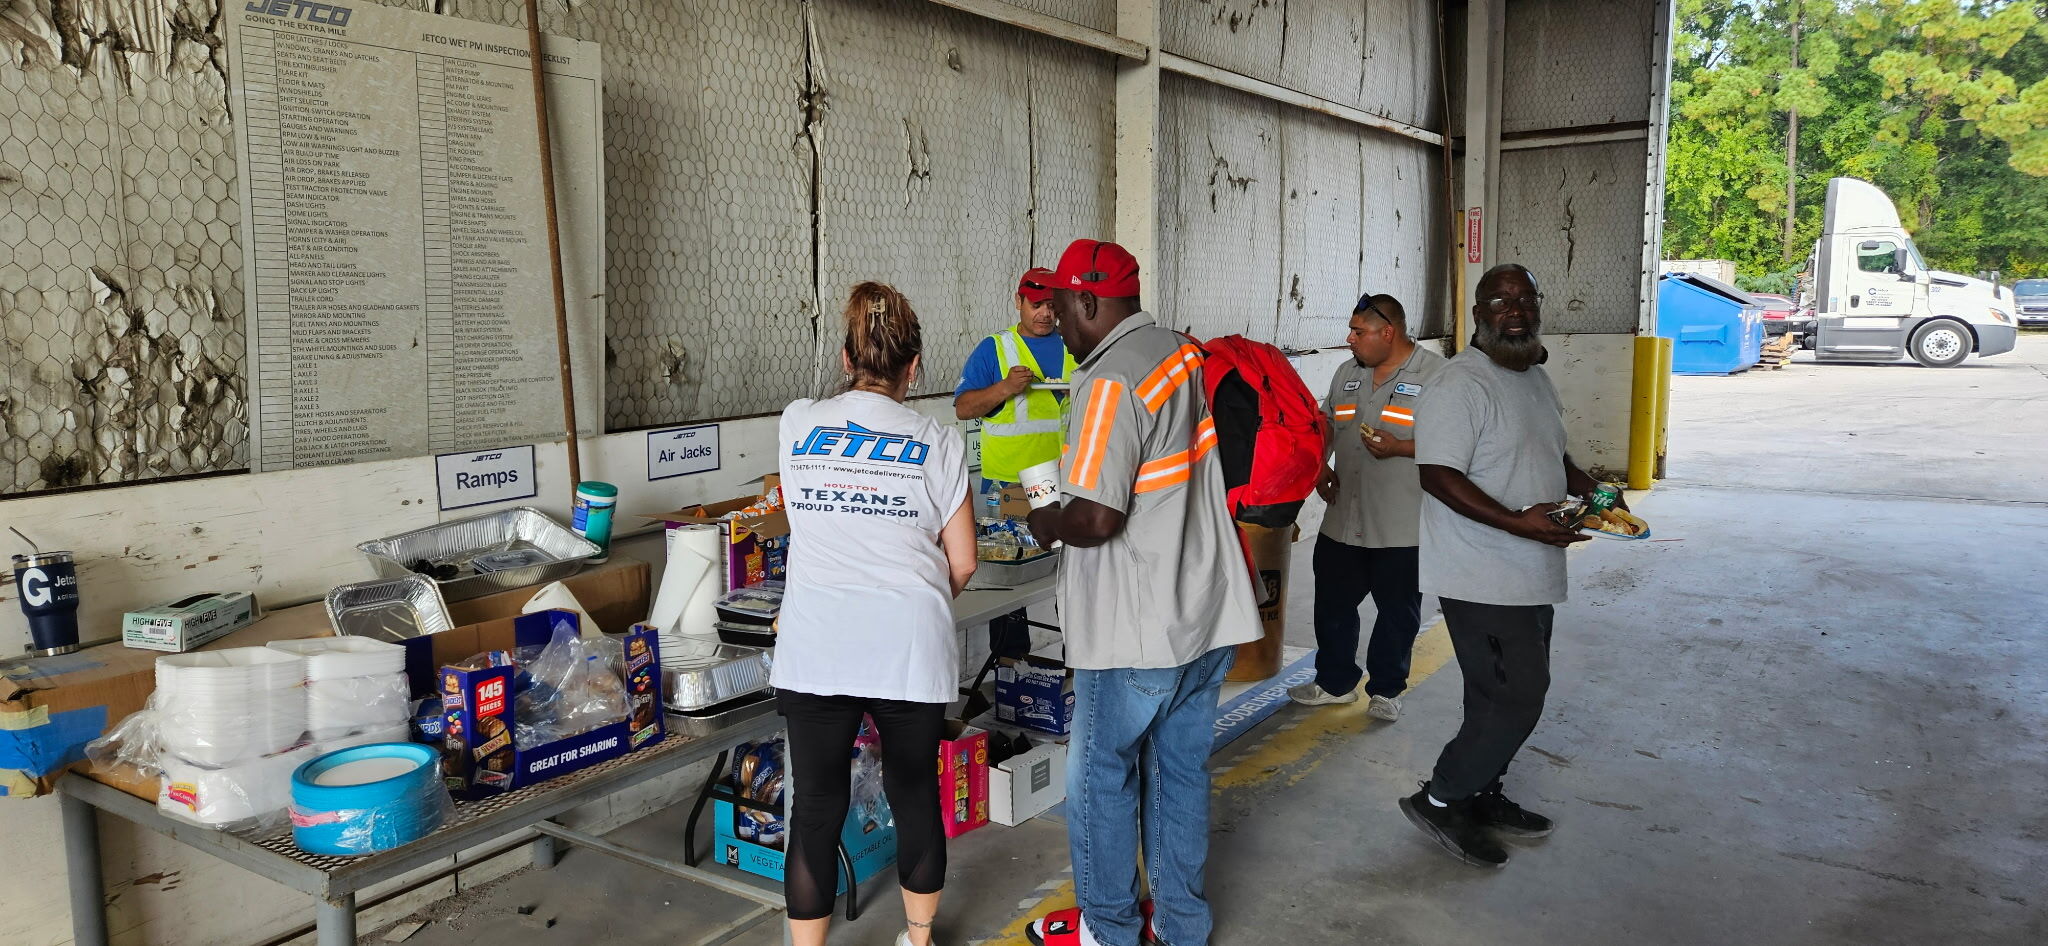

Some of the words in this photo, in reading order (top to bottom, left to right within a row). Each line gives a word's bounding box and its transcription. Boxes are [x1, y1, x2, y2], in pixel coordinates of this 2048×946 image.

[245, 0, 352, 27] JETCO
[245, 14, 275, 26] GOING
[278, 19, 295, 29] THE
[298, 22, 325, 33] EXTRA
[327, 27, 347, 37] MILE
[422, 33, 447, 44] JETCO
[449, 38, 467, 48] WET
[470, 41, 482, 50] PM
[485, 43, 531, 58] INSPECTION
[543, 53, 571, 65] ECKLIST
[278, 60, 294, 68] FIRE
[295, 62, 337, 73] EXTINGUISHER
[281, 105, 310, 114] IGNITION
[312, 108, 335, 117] SWITCH
[337, 111, 370, 120] OPERATION
[281, 113, 312, 123] STARTING
[313, 117, 349, 126] OPERATION
[282, 122, 307, 130] GAUGES
[323, 126, 357, 135] WARNINGS
[330, 187, 368, 195] PROTECTION
[350, 408, 387, 416] SEPARATORS
[673, 431, 696, 440] JETCO
[792, 420, 930, 465] JETCO
[472, 453, 502, 463] JETCO
[658, 448, 676, 463] Air
[680, 445, 712, 461] Jacks
[456, 467, 518, 490] Ramps
[833, 465, 923, 481] www.jetcodelivery.com
[824, 482, 878, 492] HOUSTON
[1025, 484, 1041, 493] FUEL
[800, 487, 907, 506] TEXANS
[840, 505, 919, 518] SPONSOR
[132, 617, 150, 626] HIGH
[184, 617, 200, 629] HIGH
[478, 680, 503, 702] 145
[479, 700, 502, 713] PIECES
[530, 757, 558, 773] GREAT
[561, 750, 578, 764] FOR
[580, 737, 618, 758] SHARING
